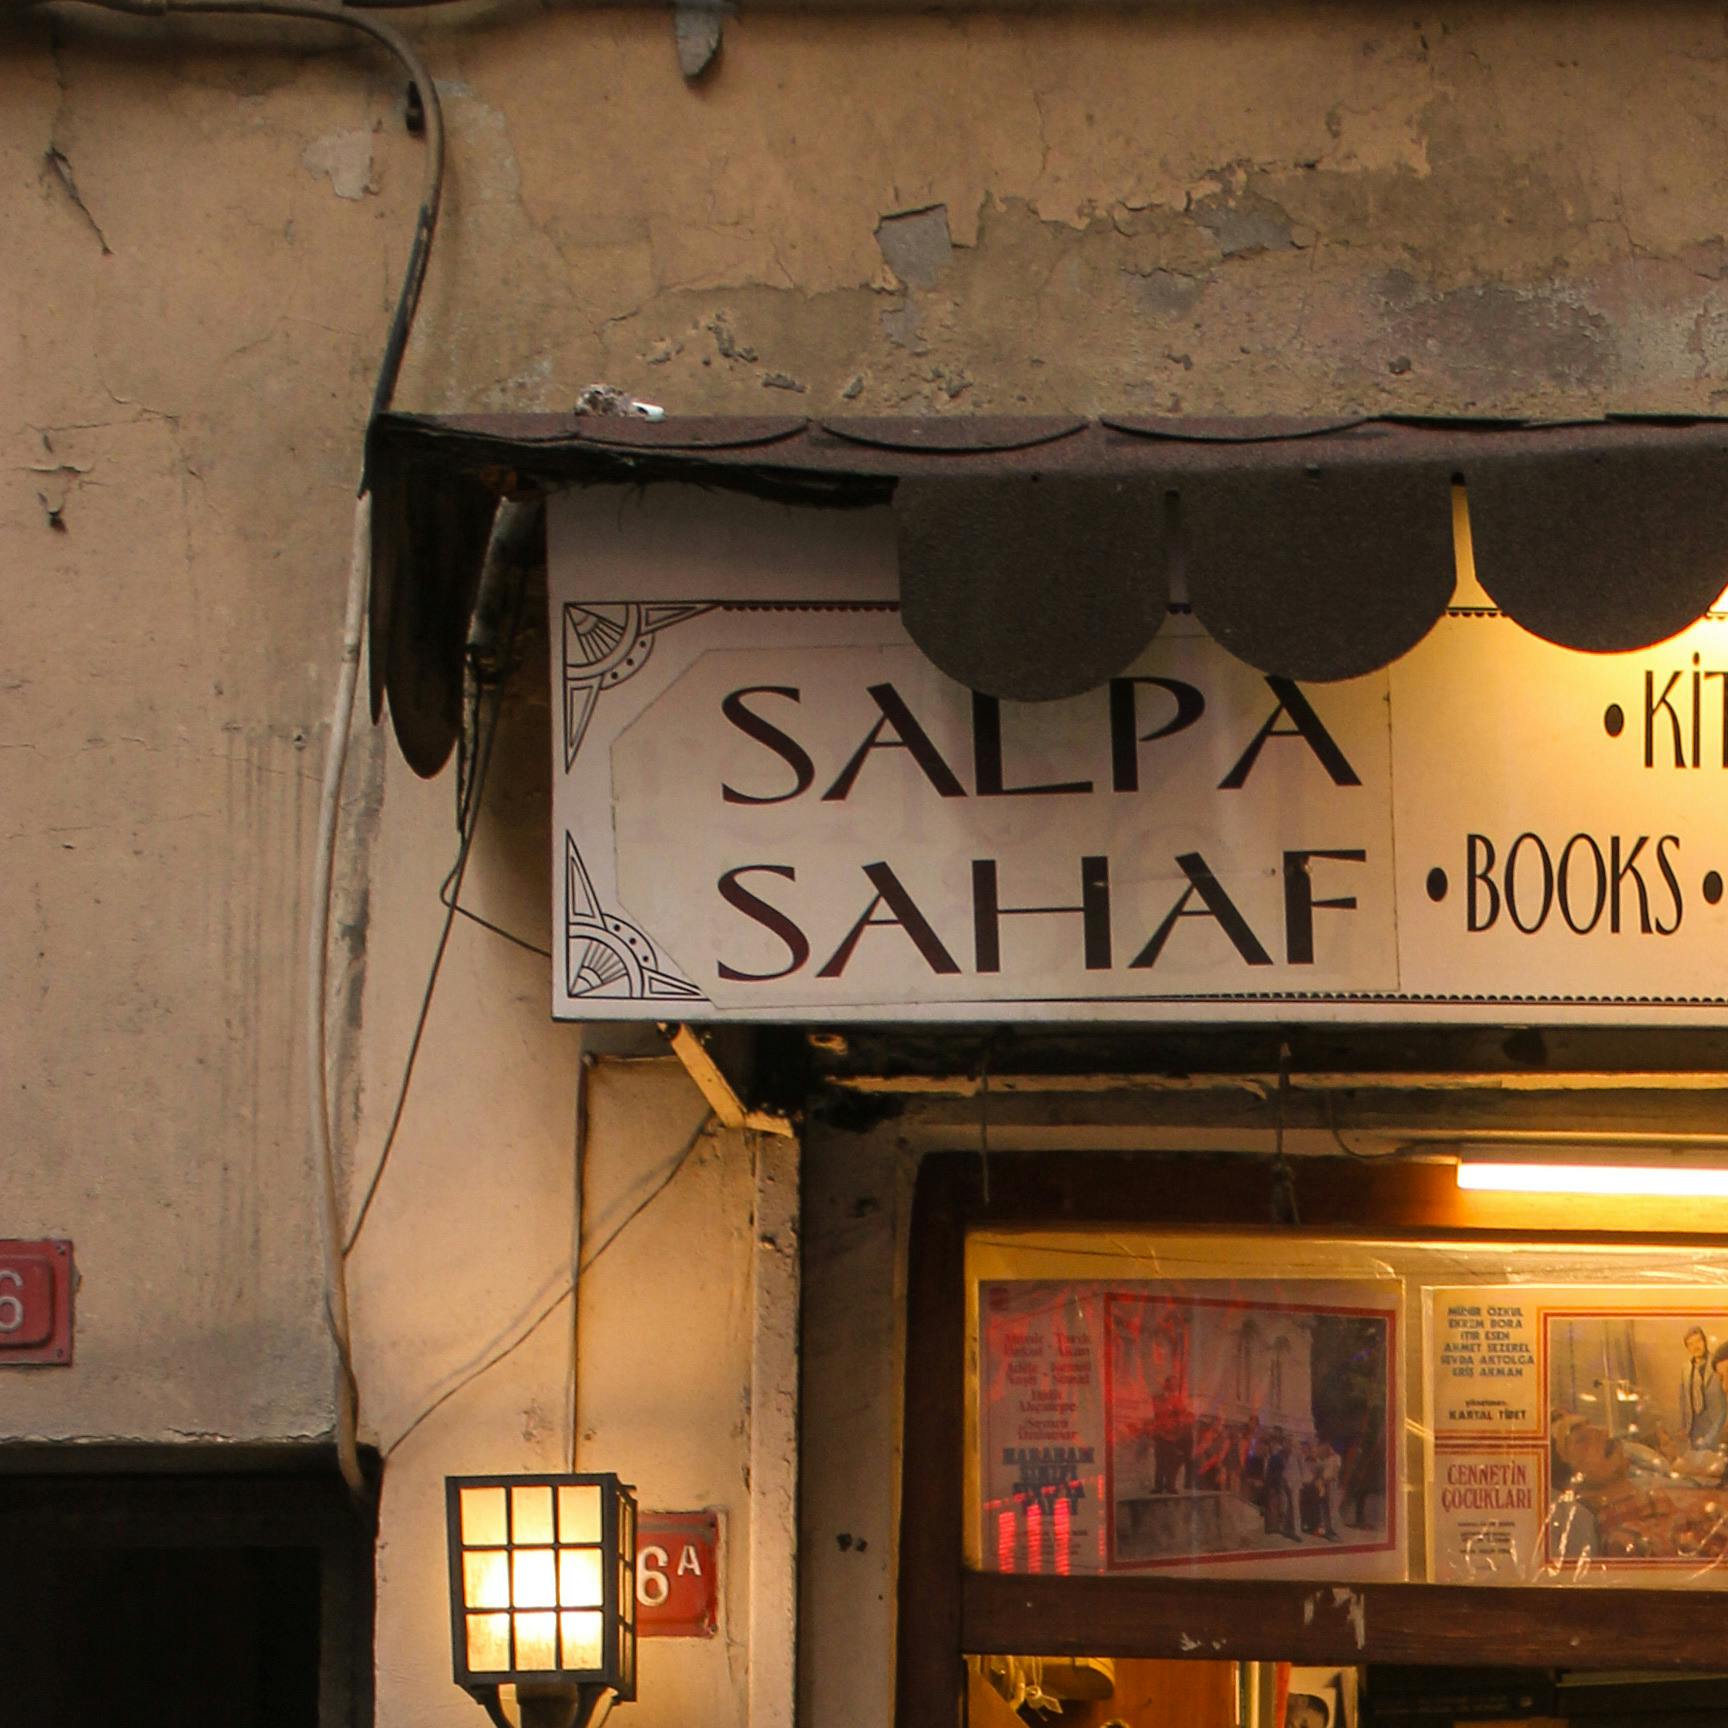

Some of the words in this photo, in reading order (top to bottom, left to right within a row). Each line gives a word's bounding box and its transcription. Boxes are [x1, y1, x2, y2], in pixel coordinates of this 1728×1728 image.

[721, 674, 1362, 806] SALPA
[716, 848, 1367, 982] SAHAF
[1466, 832, 1685, 935] BOOKS
[1441, 1487, 1532, 1512] ÇOCUKLARI
[1447, 1461, 1527, 1486] CENNETİN
